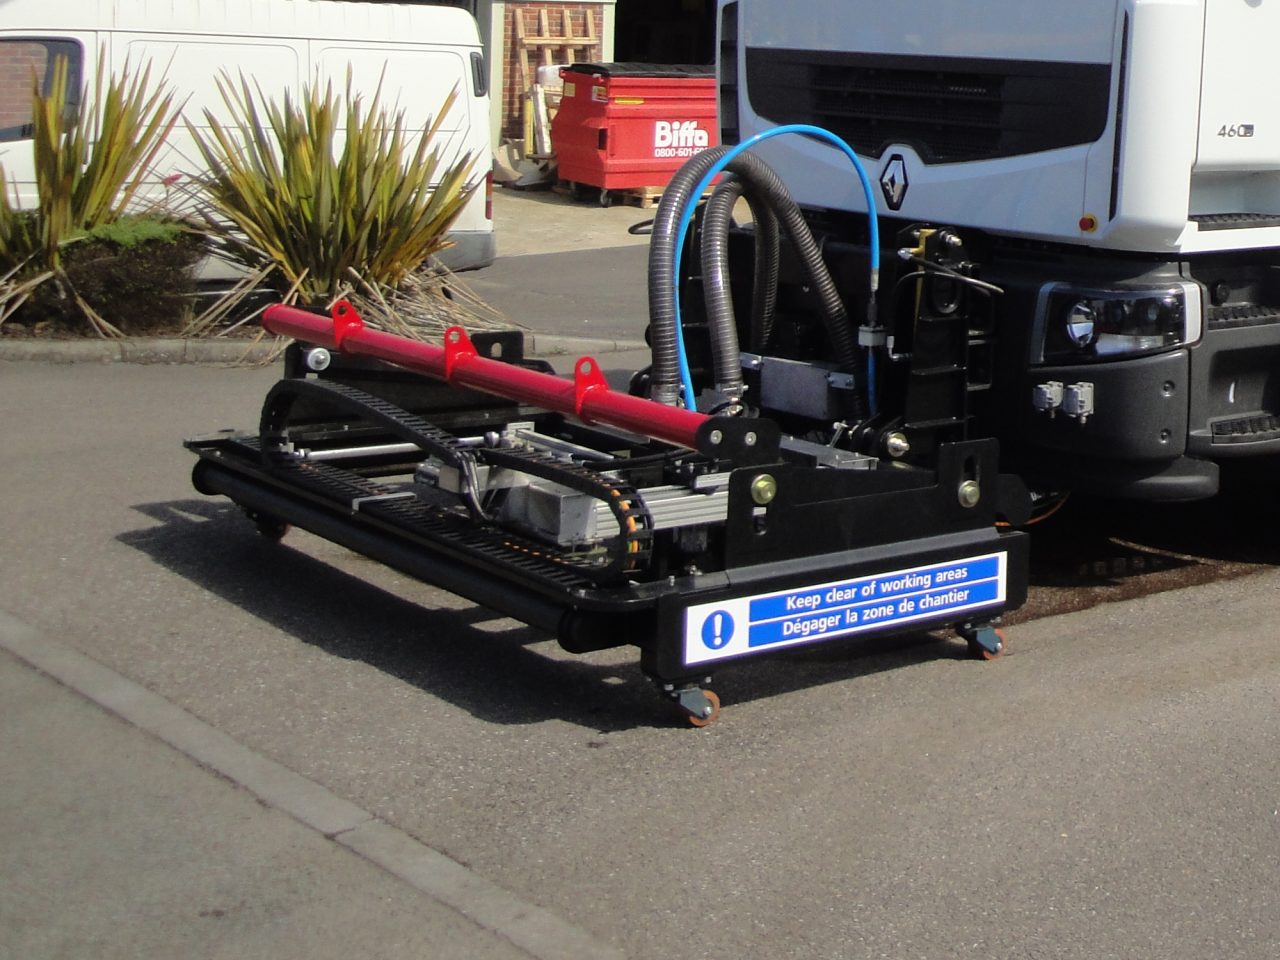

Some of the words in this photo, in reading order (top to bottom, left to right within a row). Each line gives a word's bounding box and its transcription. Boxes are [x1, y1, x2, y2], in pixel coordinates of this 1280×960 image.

[654, 120, 709, 148] Biffa
[655, 147, 708, 158] 0800-601-6
[786, 594, 821, 610] Keep
[825, 587, 857, 603] clear
[861, 581, 876, 596] of
[880, 573, 932, 593] working
[935, 567, 968, 583] areas
[783, 614, 841, 637] Dégager
[845, 609, 858, 624] la
[862, 605, 894, 620] zone
[898, 598, 915, 613] de
[919, 589, 970, 609] chantier
